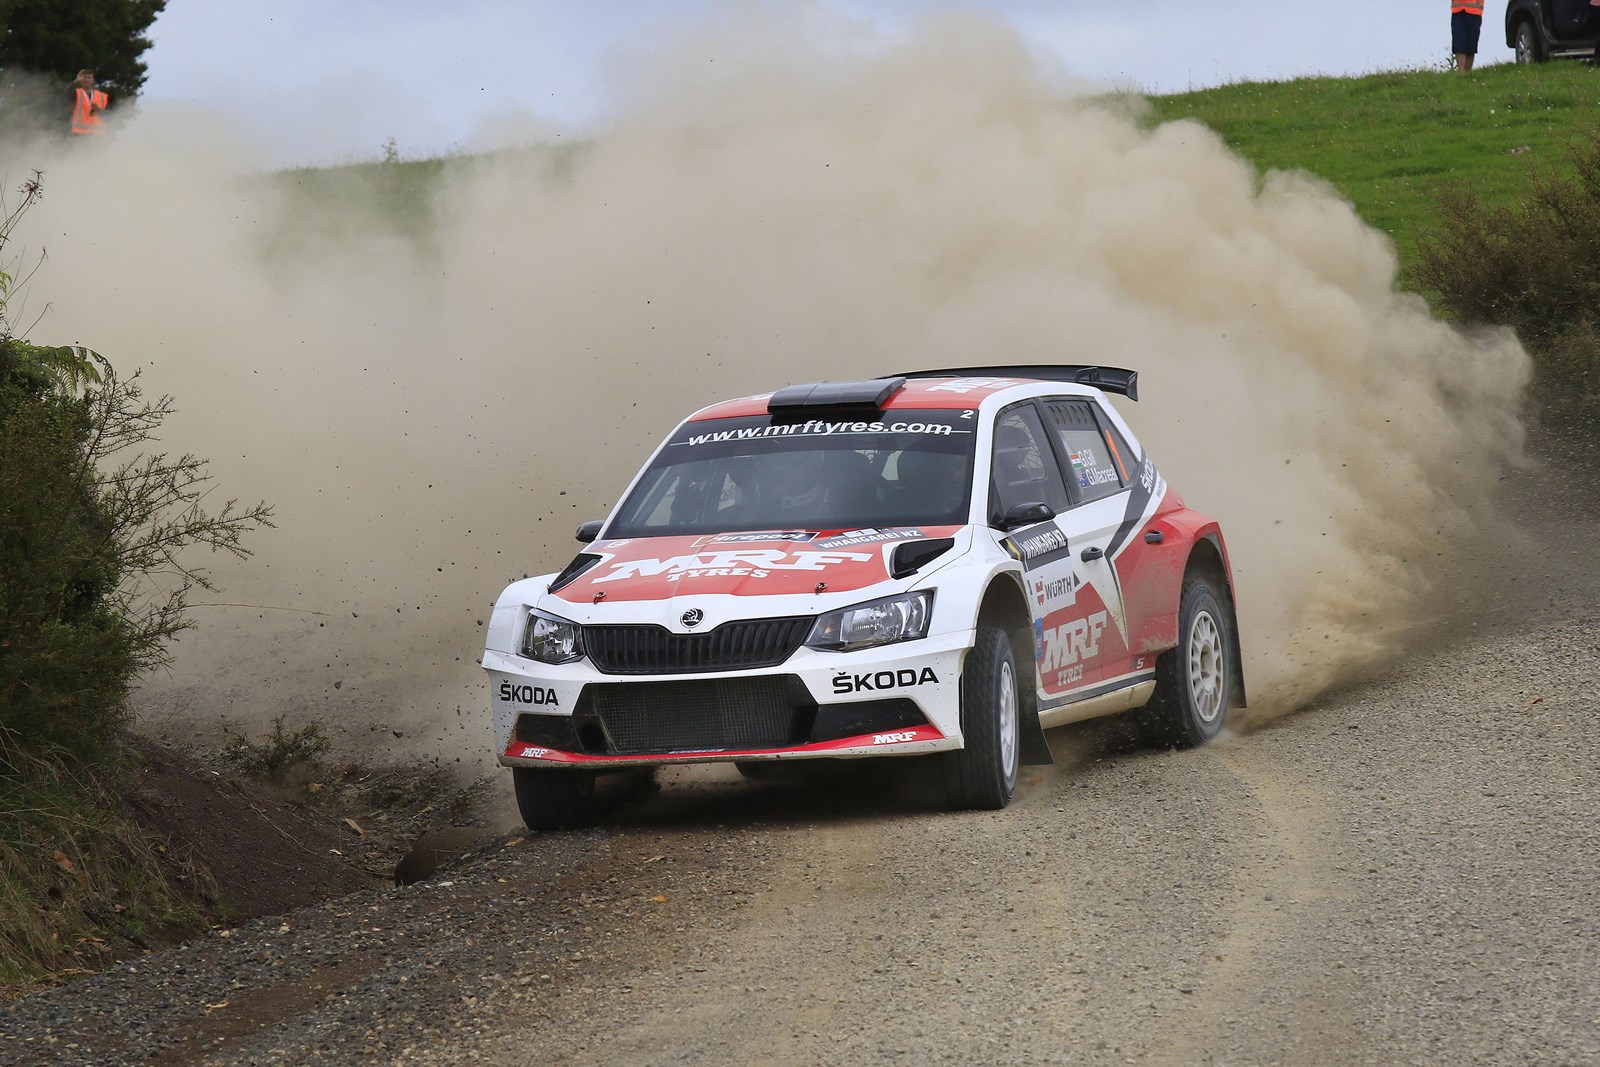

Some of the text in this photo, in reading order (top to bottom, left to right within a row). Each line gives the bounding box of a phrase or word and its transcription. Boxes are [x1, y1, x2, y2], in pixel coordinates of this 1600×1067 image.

[960, 410, 974, 419] 2
[688, 420, 953, 446] www.mrftyres.com
[819, 532, 899, 549] WHANGAREI
[591, 549, 874, 584] MRF
[667, 567, 769, 582] TYRES
[1045, 576, 1072, 600] WÜRTH
[1041, 609, 1107, 674] MRF
[832, 666, 939, 694] ŠKODA
[1057, 664, 1084, 686] TYRES
[500, 680, 559, 706] ŠKODA
[873, 731, 917, 744] MRF
[520, 747, 548, 758] MRF
